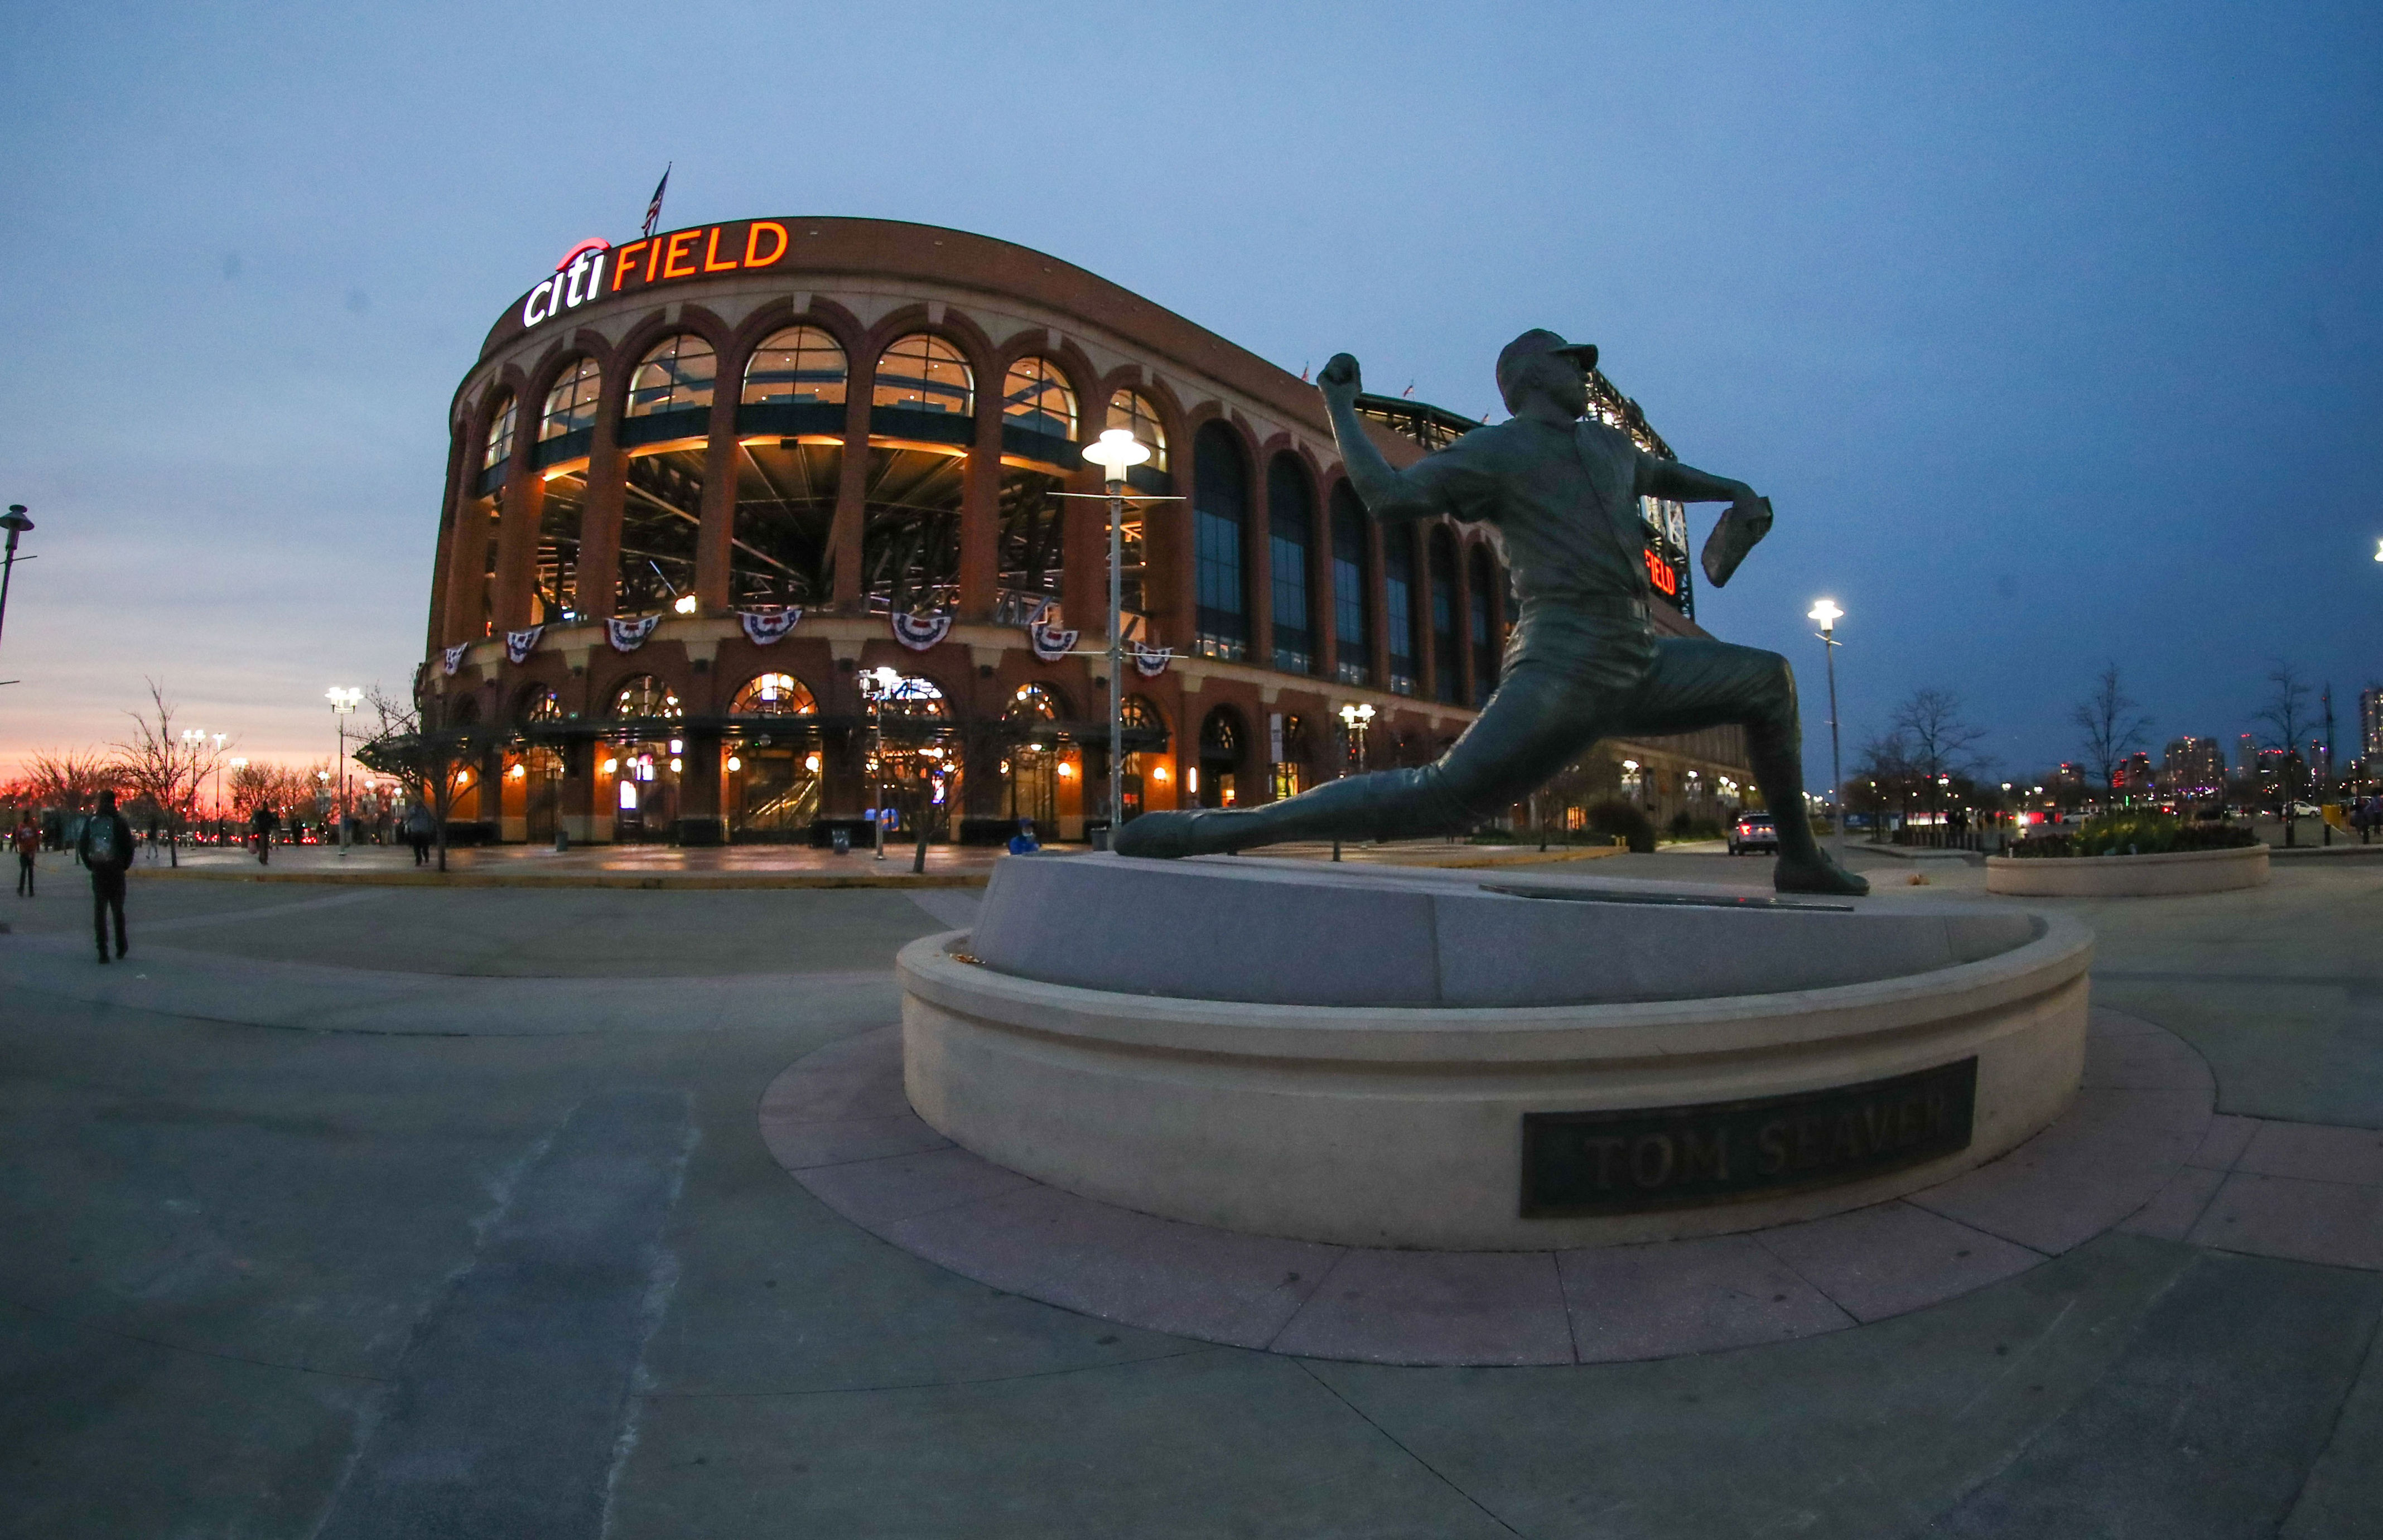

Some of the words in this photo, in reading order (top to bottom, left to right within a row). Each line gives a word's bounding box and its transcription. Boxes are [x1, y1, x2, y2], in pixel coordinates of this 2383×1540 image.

[523, 252, 606, 328] citi
[612, 221, 789, 292] FIELD
[1583, 1127, 1729, 1190] TOM
[1757, 1089, 1947, 1175] SEAVER
